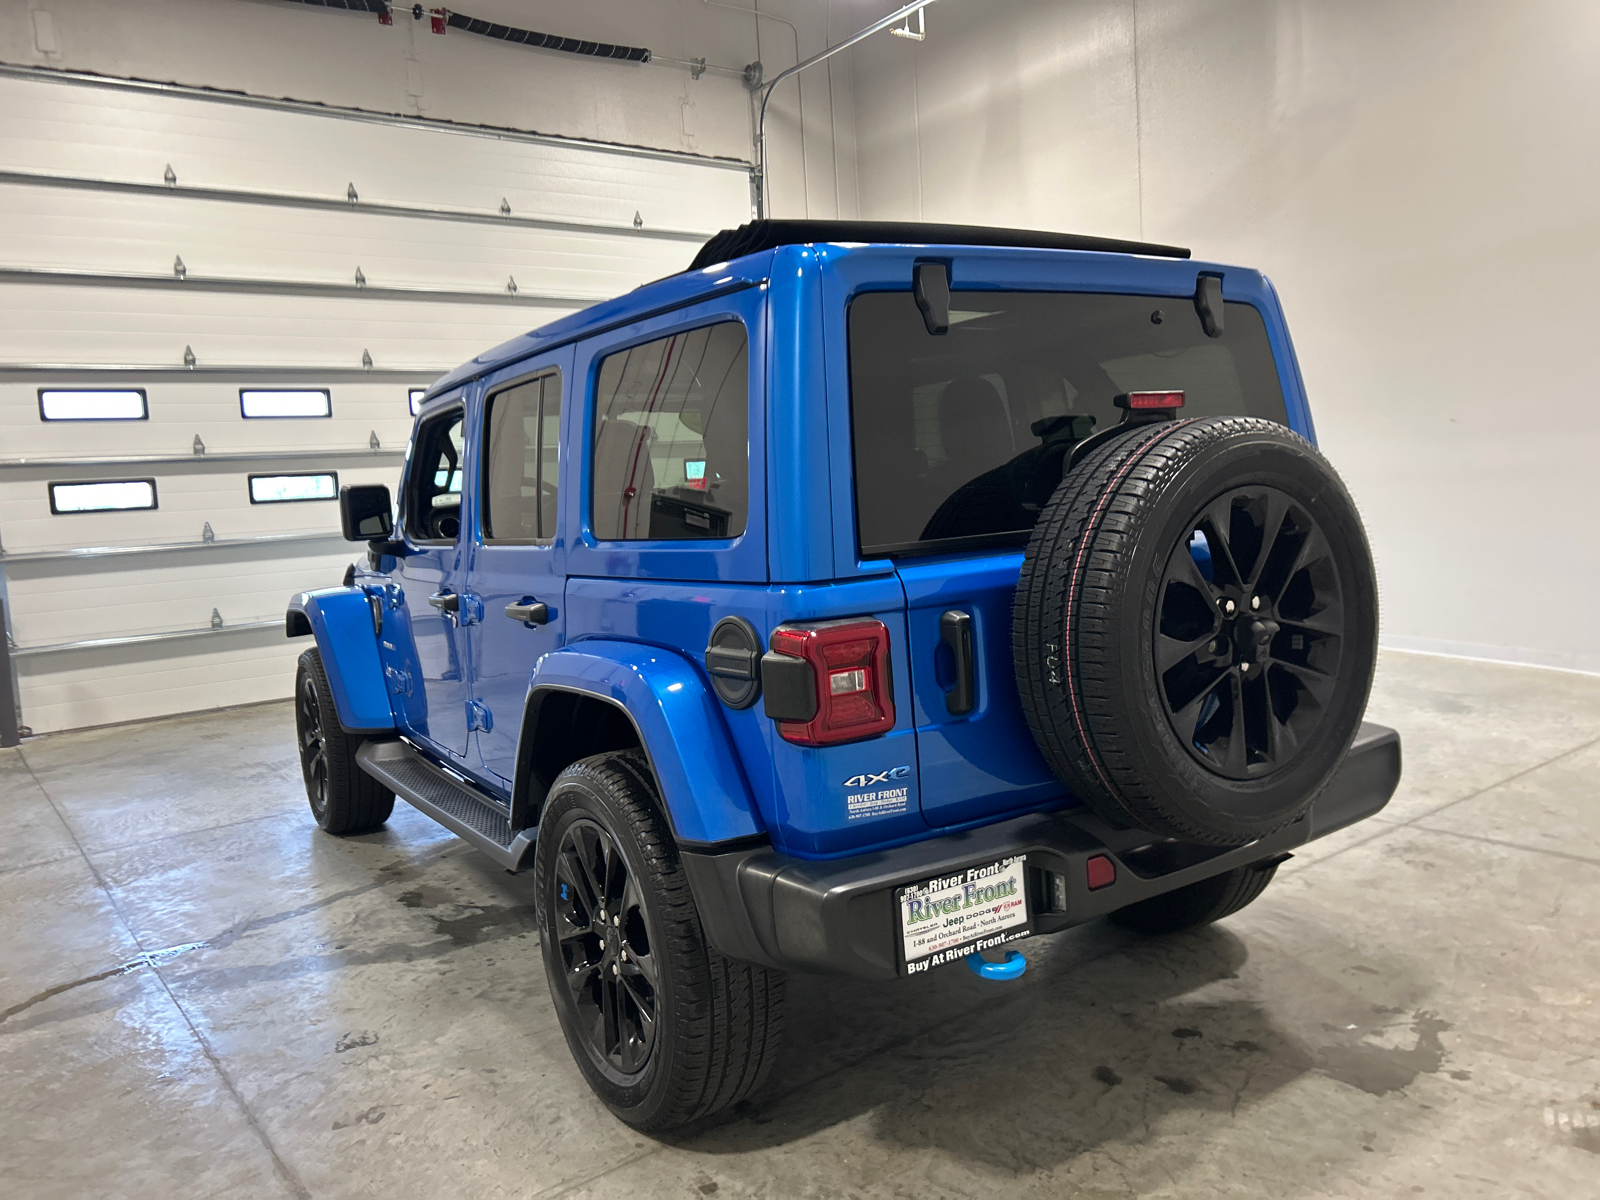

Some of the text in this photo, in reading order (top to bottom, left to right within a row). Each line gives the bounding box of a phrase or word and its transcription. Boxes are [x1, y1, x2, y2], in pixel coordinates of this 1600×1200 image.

[847, 787, 908, 804] RIVER FRONT
[929, 873, 964, 894] River
[967, 862, 1000, 883] Front
[907, 876, 1017, 925] River Front
[906, 899, 1023, 935] CHRYSLER Jeep DODGE RAM
[913, 913, 1016, 948] I-88 and Orchard Road North Aurora
[907, 958, 931, 975] Buy
[931, 954, 945, 967] At
[945, 944, 976, 961] River
[928, 937, 960, 952] 630-907-1700
